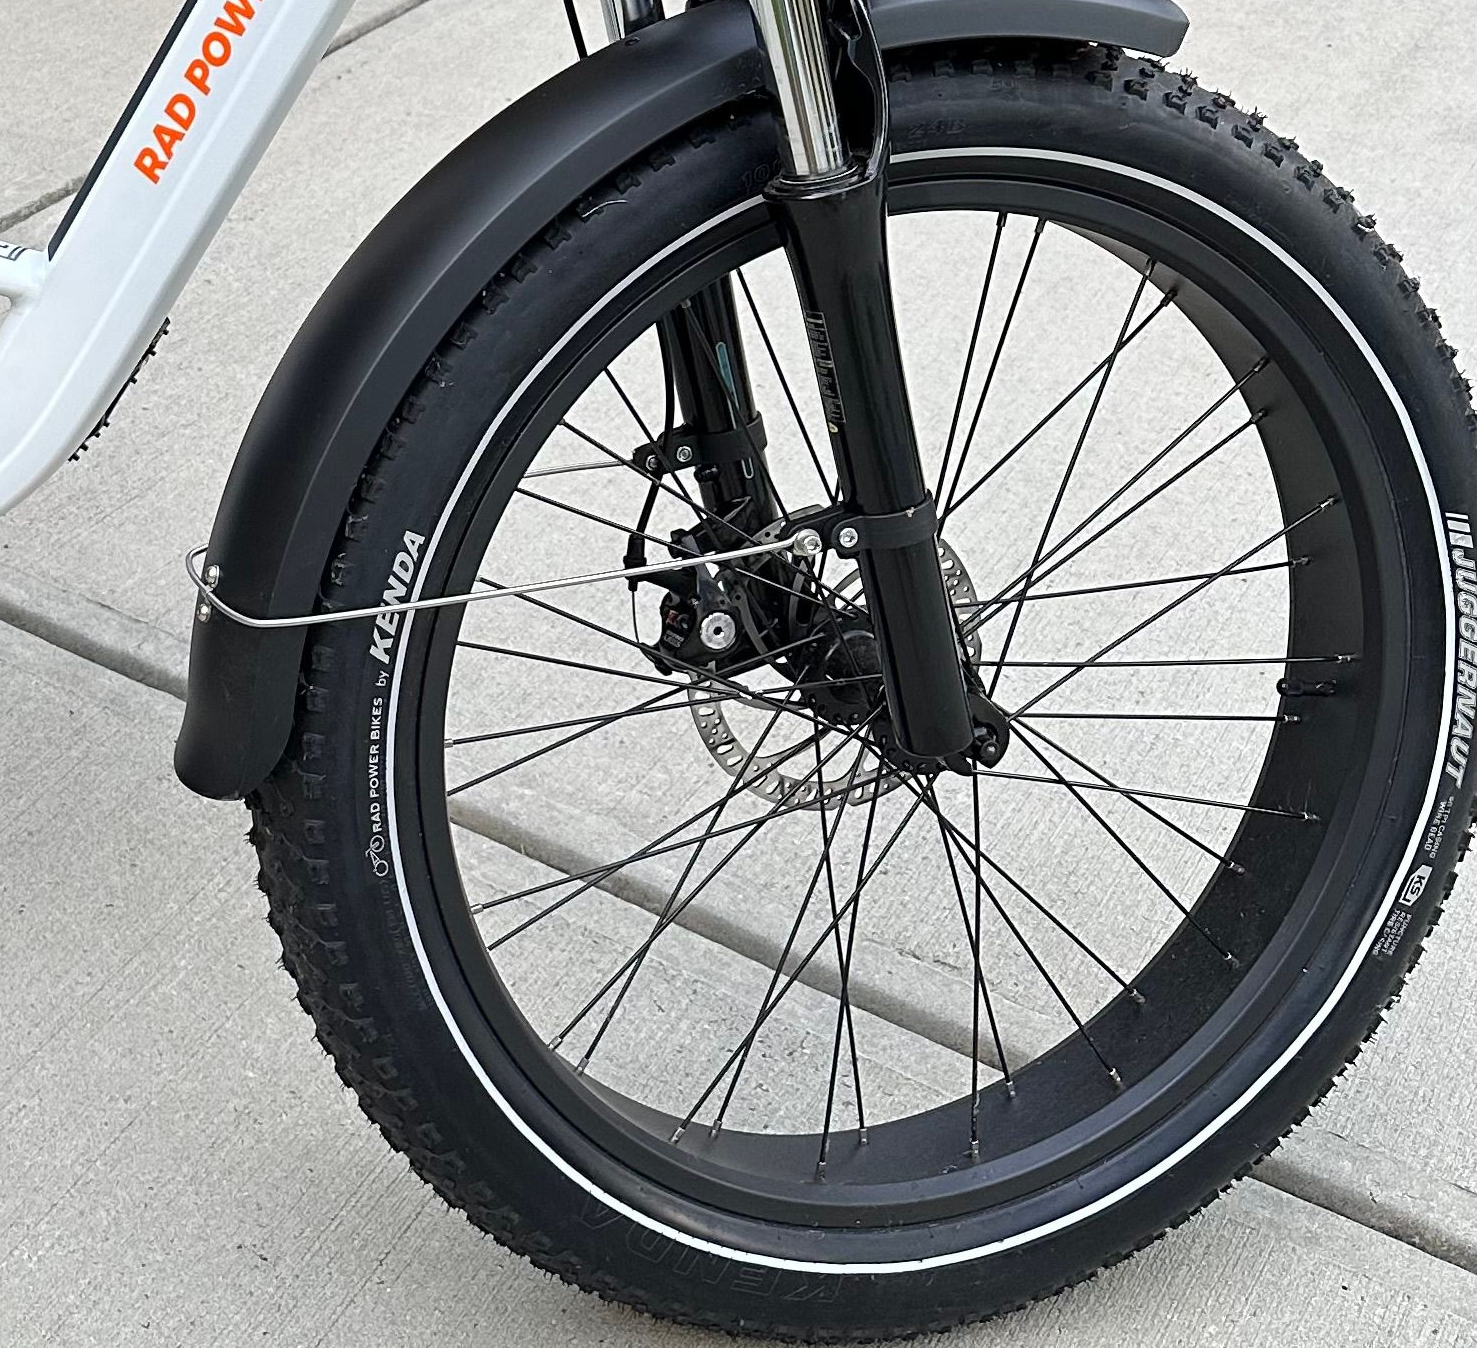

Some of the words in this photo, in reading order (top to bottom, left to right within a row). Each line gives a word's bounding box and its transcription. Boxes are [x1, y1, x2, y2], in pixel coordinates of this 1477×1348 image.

[134, 92, 196, 184] RAD
[369, 530, 426, 665] KENDA
[375, 670, 390, 687] by
[1446, 548, 1477, 789] JUGGERNAUT
[370, 697, 383, 740] BIKES
[369, 744, 380, 798] POWER
[370, 802, 383, 833] RAD
